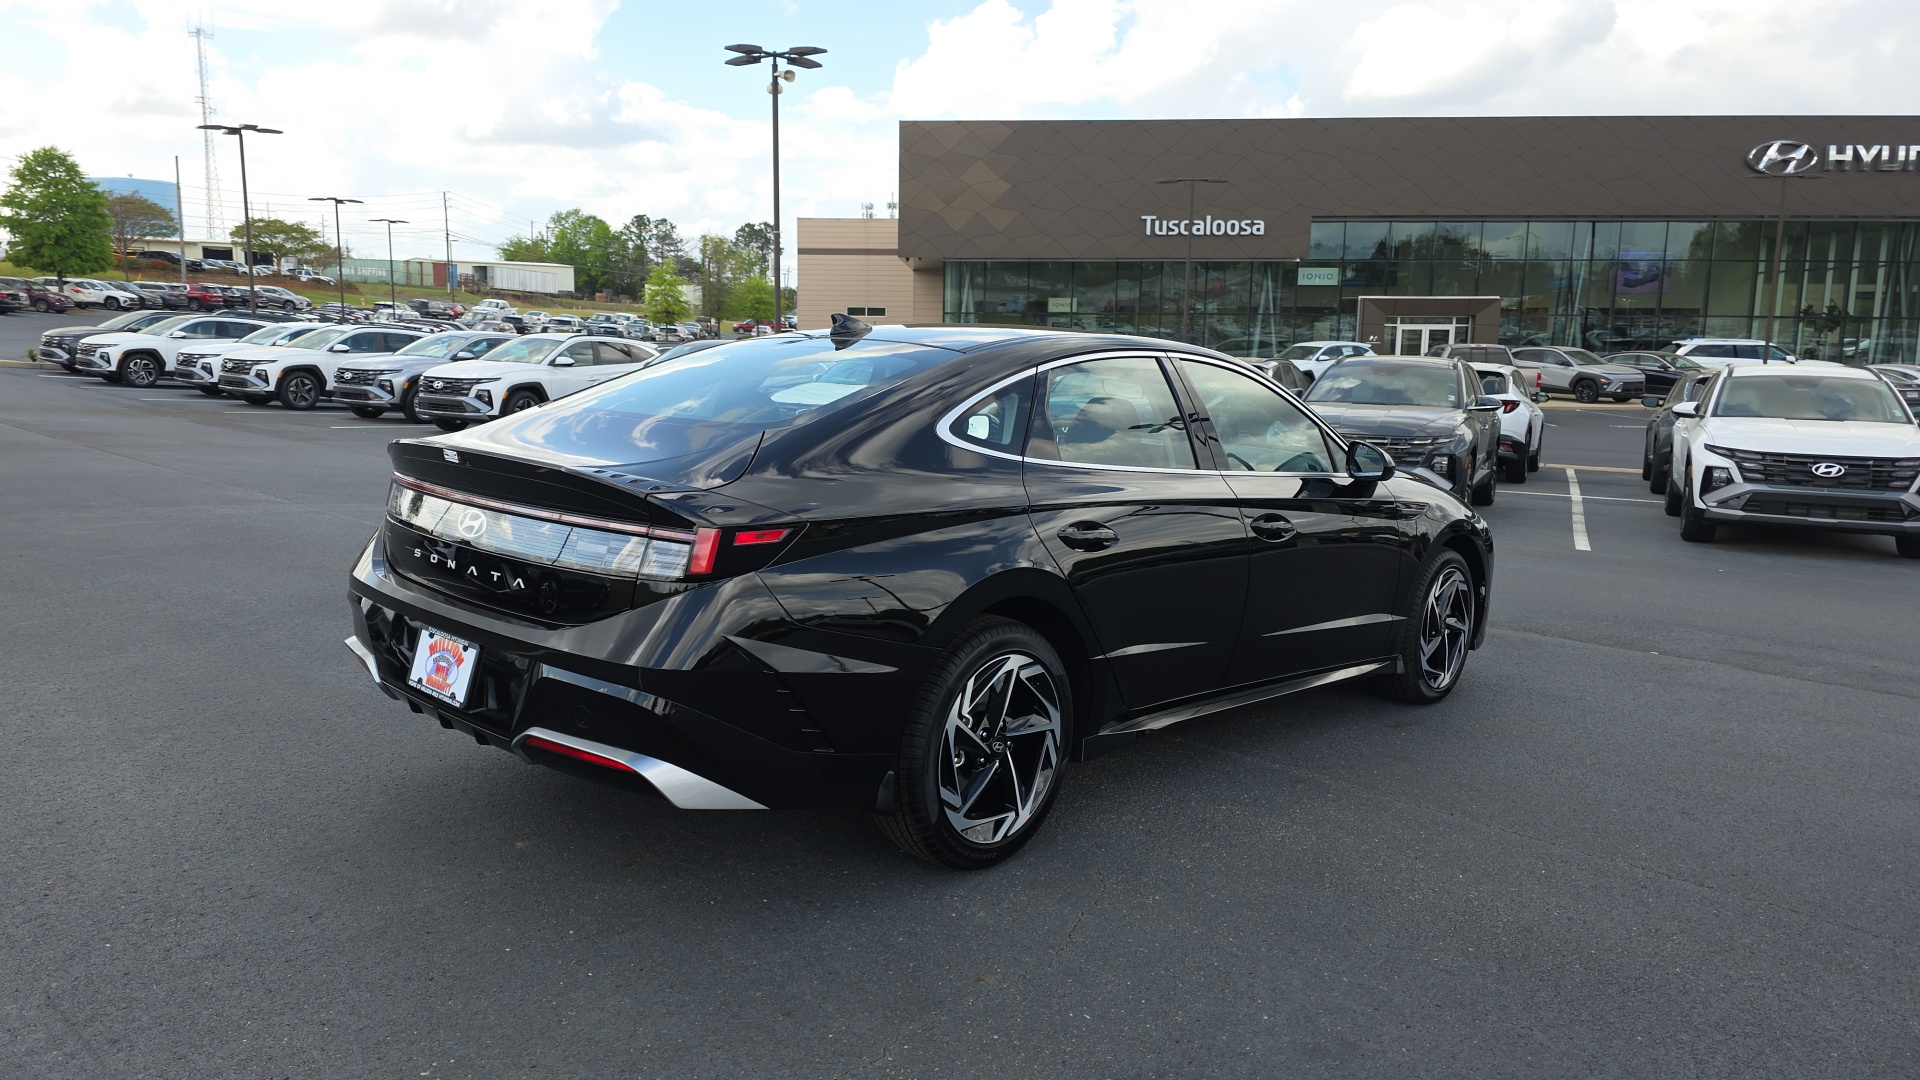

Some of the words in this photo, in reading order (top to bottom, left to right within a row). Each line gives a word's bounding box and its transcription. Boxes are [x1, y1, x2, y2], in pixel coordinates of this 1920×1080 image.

[1141, 215, 1265, 236] Tuscaloosa
[357, 266, 386, 276] SHIPPING
[1302, 272, 1334, 280] IONIQ
[413, 548, 525, 589] SONATA
[428, 637, 465, 668] MILLION
[434, 663, 449, 681] MILE
